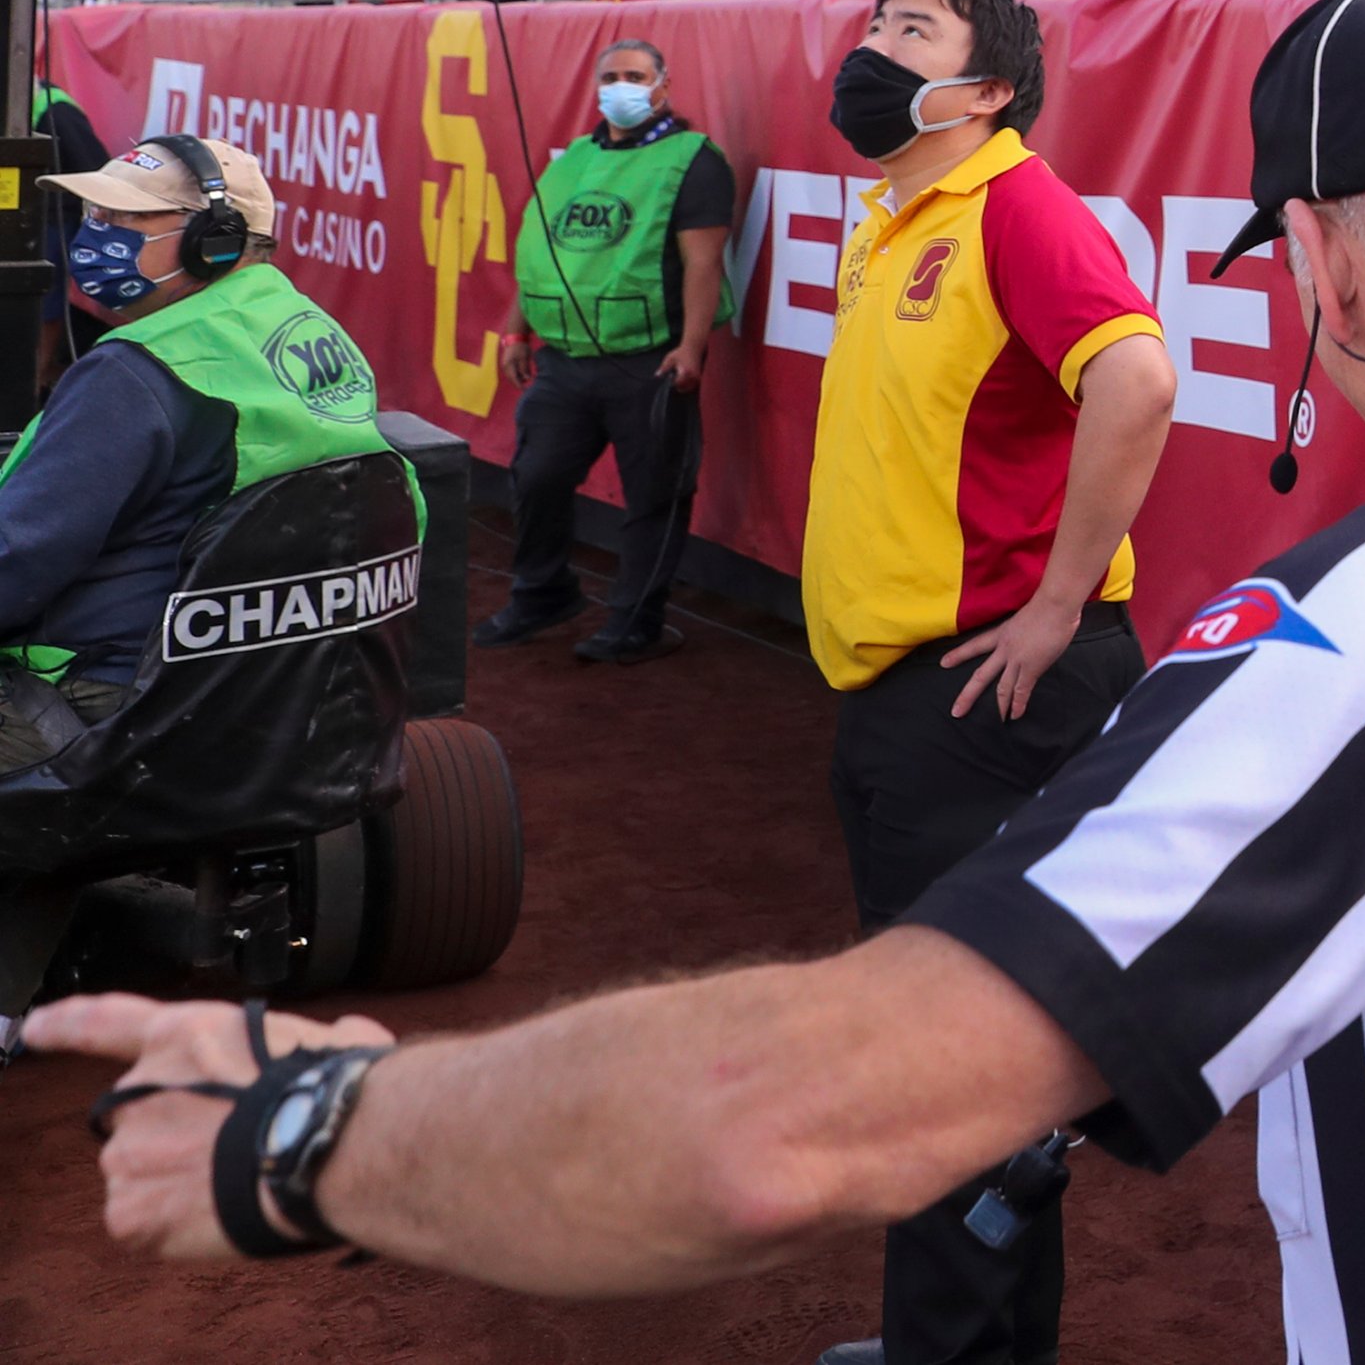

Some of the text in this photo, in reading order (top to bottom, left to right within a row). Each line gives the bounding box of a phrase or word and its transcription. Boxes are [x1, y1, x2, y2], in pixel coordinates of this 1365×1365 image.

[208, 94, 387, 200] PECHANGA
[291, 207, 387, 275] CASINO
[565, 203, 616, 227] FOX
[902, 300, 929, 316] CSC
[172, 554, 419, 650] CHAPMAN
